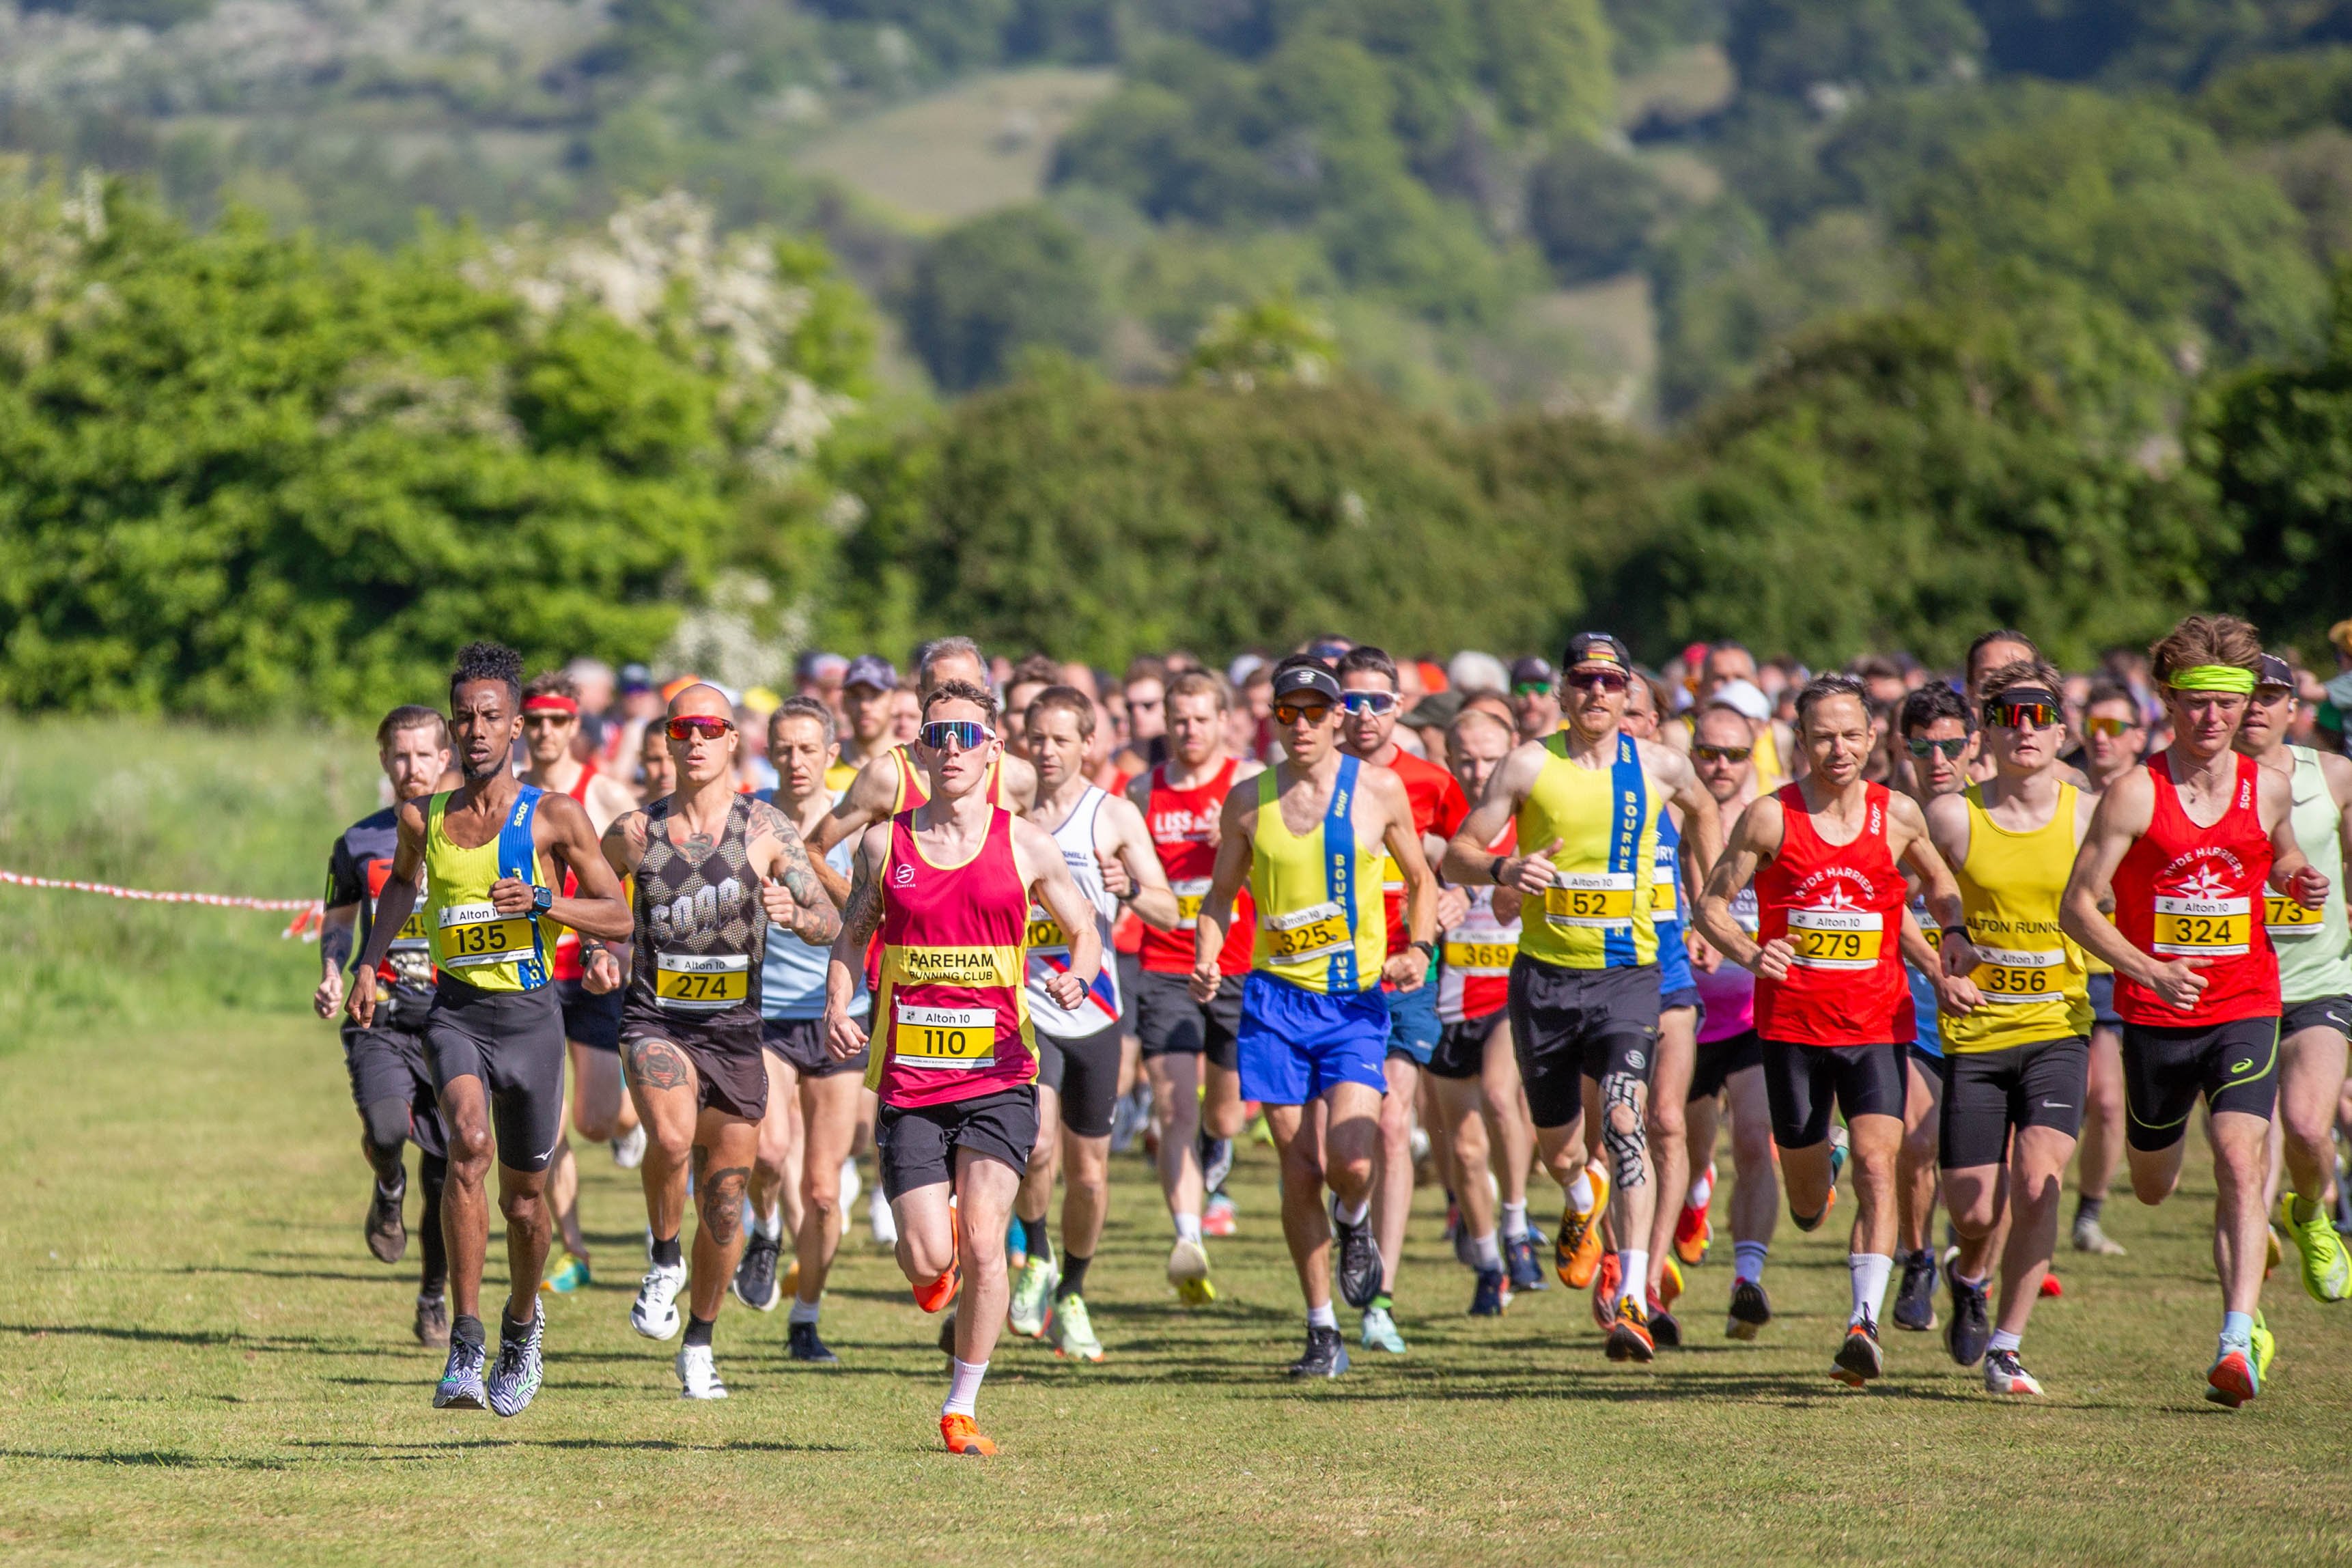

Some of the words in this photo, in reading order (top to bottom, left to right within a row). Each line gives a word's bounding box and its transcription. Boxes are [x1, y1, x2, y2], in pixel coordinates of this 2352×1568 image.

[514, 802, 529, 827] soar
[1571, 877, 1600, 886] Alton
[1602, 878, 1613, 886] 10
[1573, 893, 1606, 914] 52
[2185, 903, 2215, 913] Alton
[2218, 904, 2229, 912] 10
[2269, 901, 2303, 922] 73
[459, 908, 489, 921] Alton
[1816, 918, 1846, 927] Alton
[1850, 919, 1861, 927] 10
[1965, 916, 2010, 934] ALTON
[2015, 922, 2061, 934] RUNN
[2175, 918, 2232, 942] 324
[456, 924, 507, 953] 135
[1280, 923, 1329, 953] 325
[1808, 933, 1861, 957] 279
[909, 953, 994, 968] FAREHAM
[1464, 945, 1509, 965] 369
[2001, 954, 2031, 964] Alton
[2034, 955, 2045, 964] 10
[684, 961, 713, 970] Alton
[716, 961, 725, 970] 10
[909, 971, 960, 981] RUNNING
[964, 971, 993, 981] CLUB
[1990, 968, 2046, 992] 356
[677, 975, 727, 998] 274
[925, 1013, 956, 1024] Alton
[960, 1014, 970, 1023] 10
[924, 1029, 966, 1055] 110
